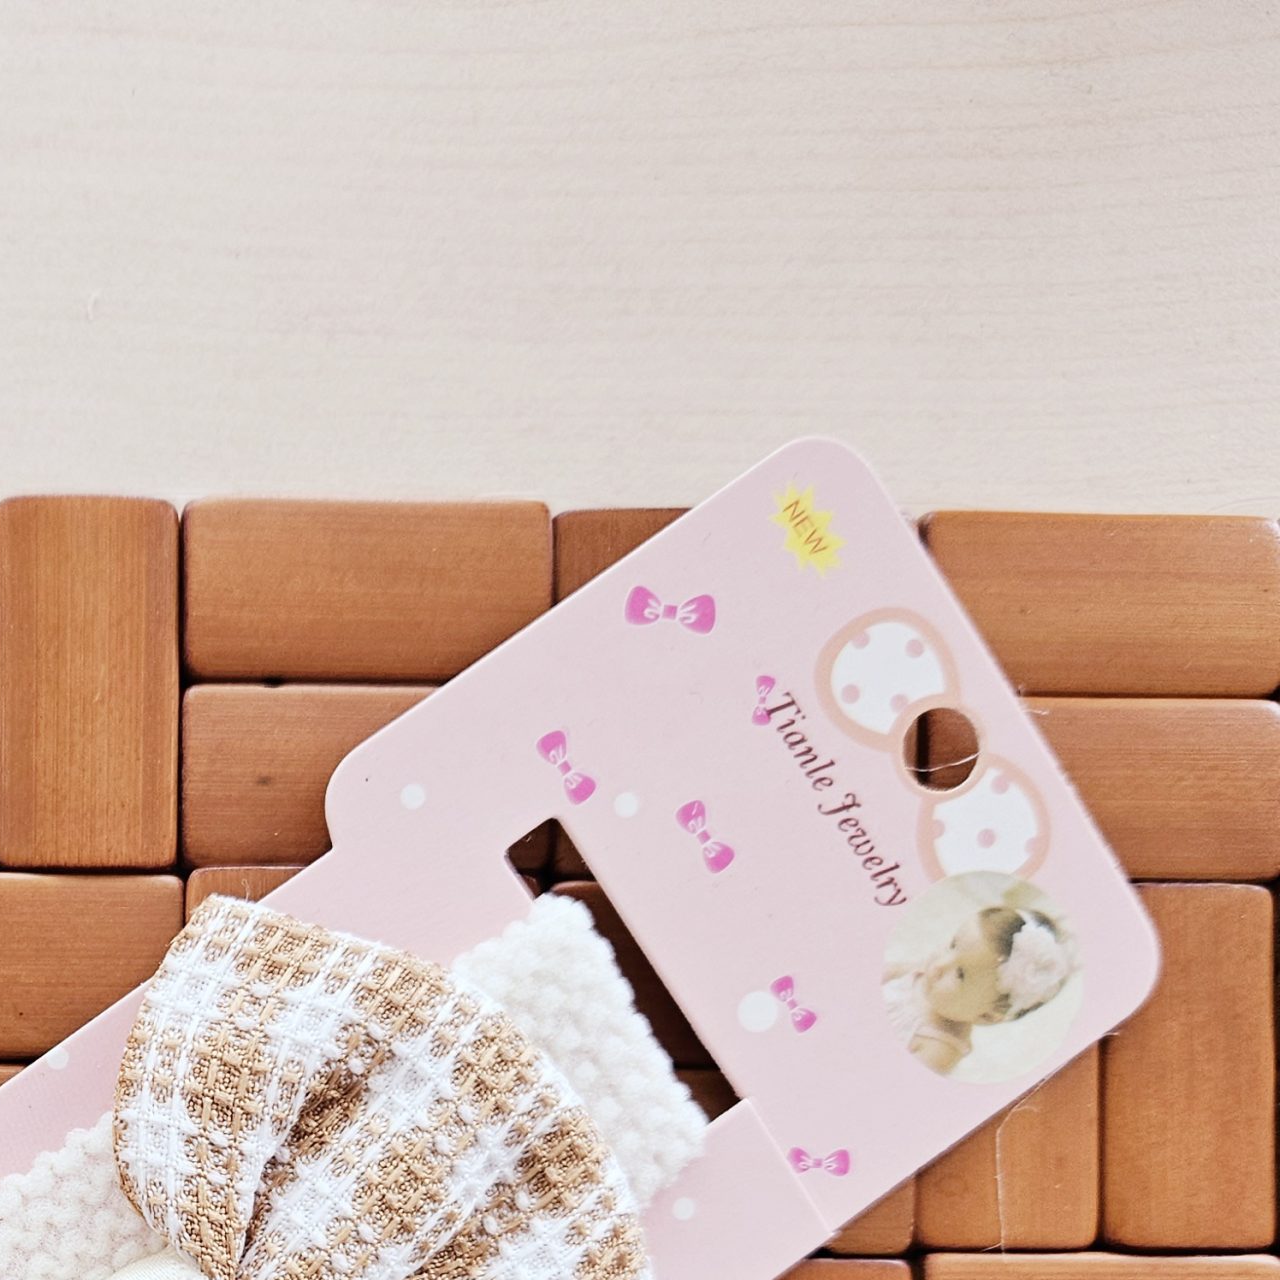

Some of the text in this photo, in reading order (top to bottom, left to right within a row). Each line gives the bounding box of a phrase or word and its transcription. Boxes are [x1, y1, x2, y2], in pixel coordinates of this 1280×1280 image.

[782, 498, 829, 555] NEW
[765, 691, 907, 907] Tianle Jewelry
